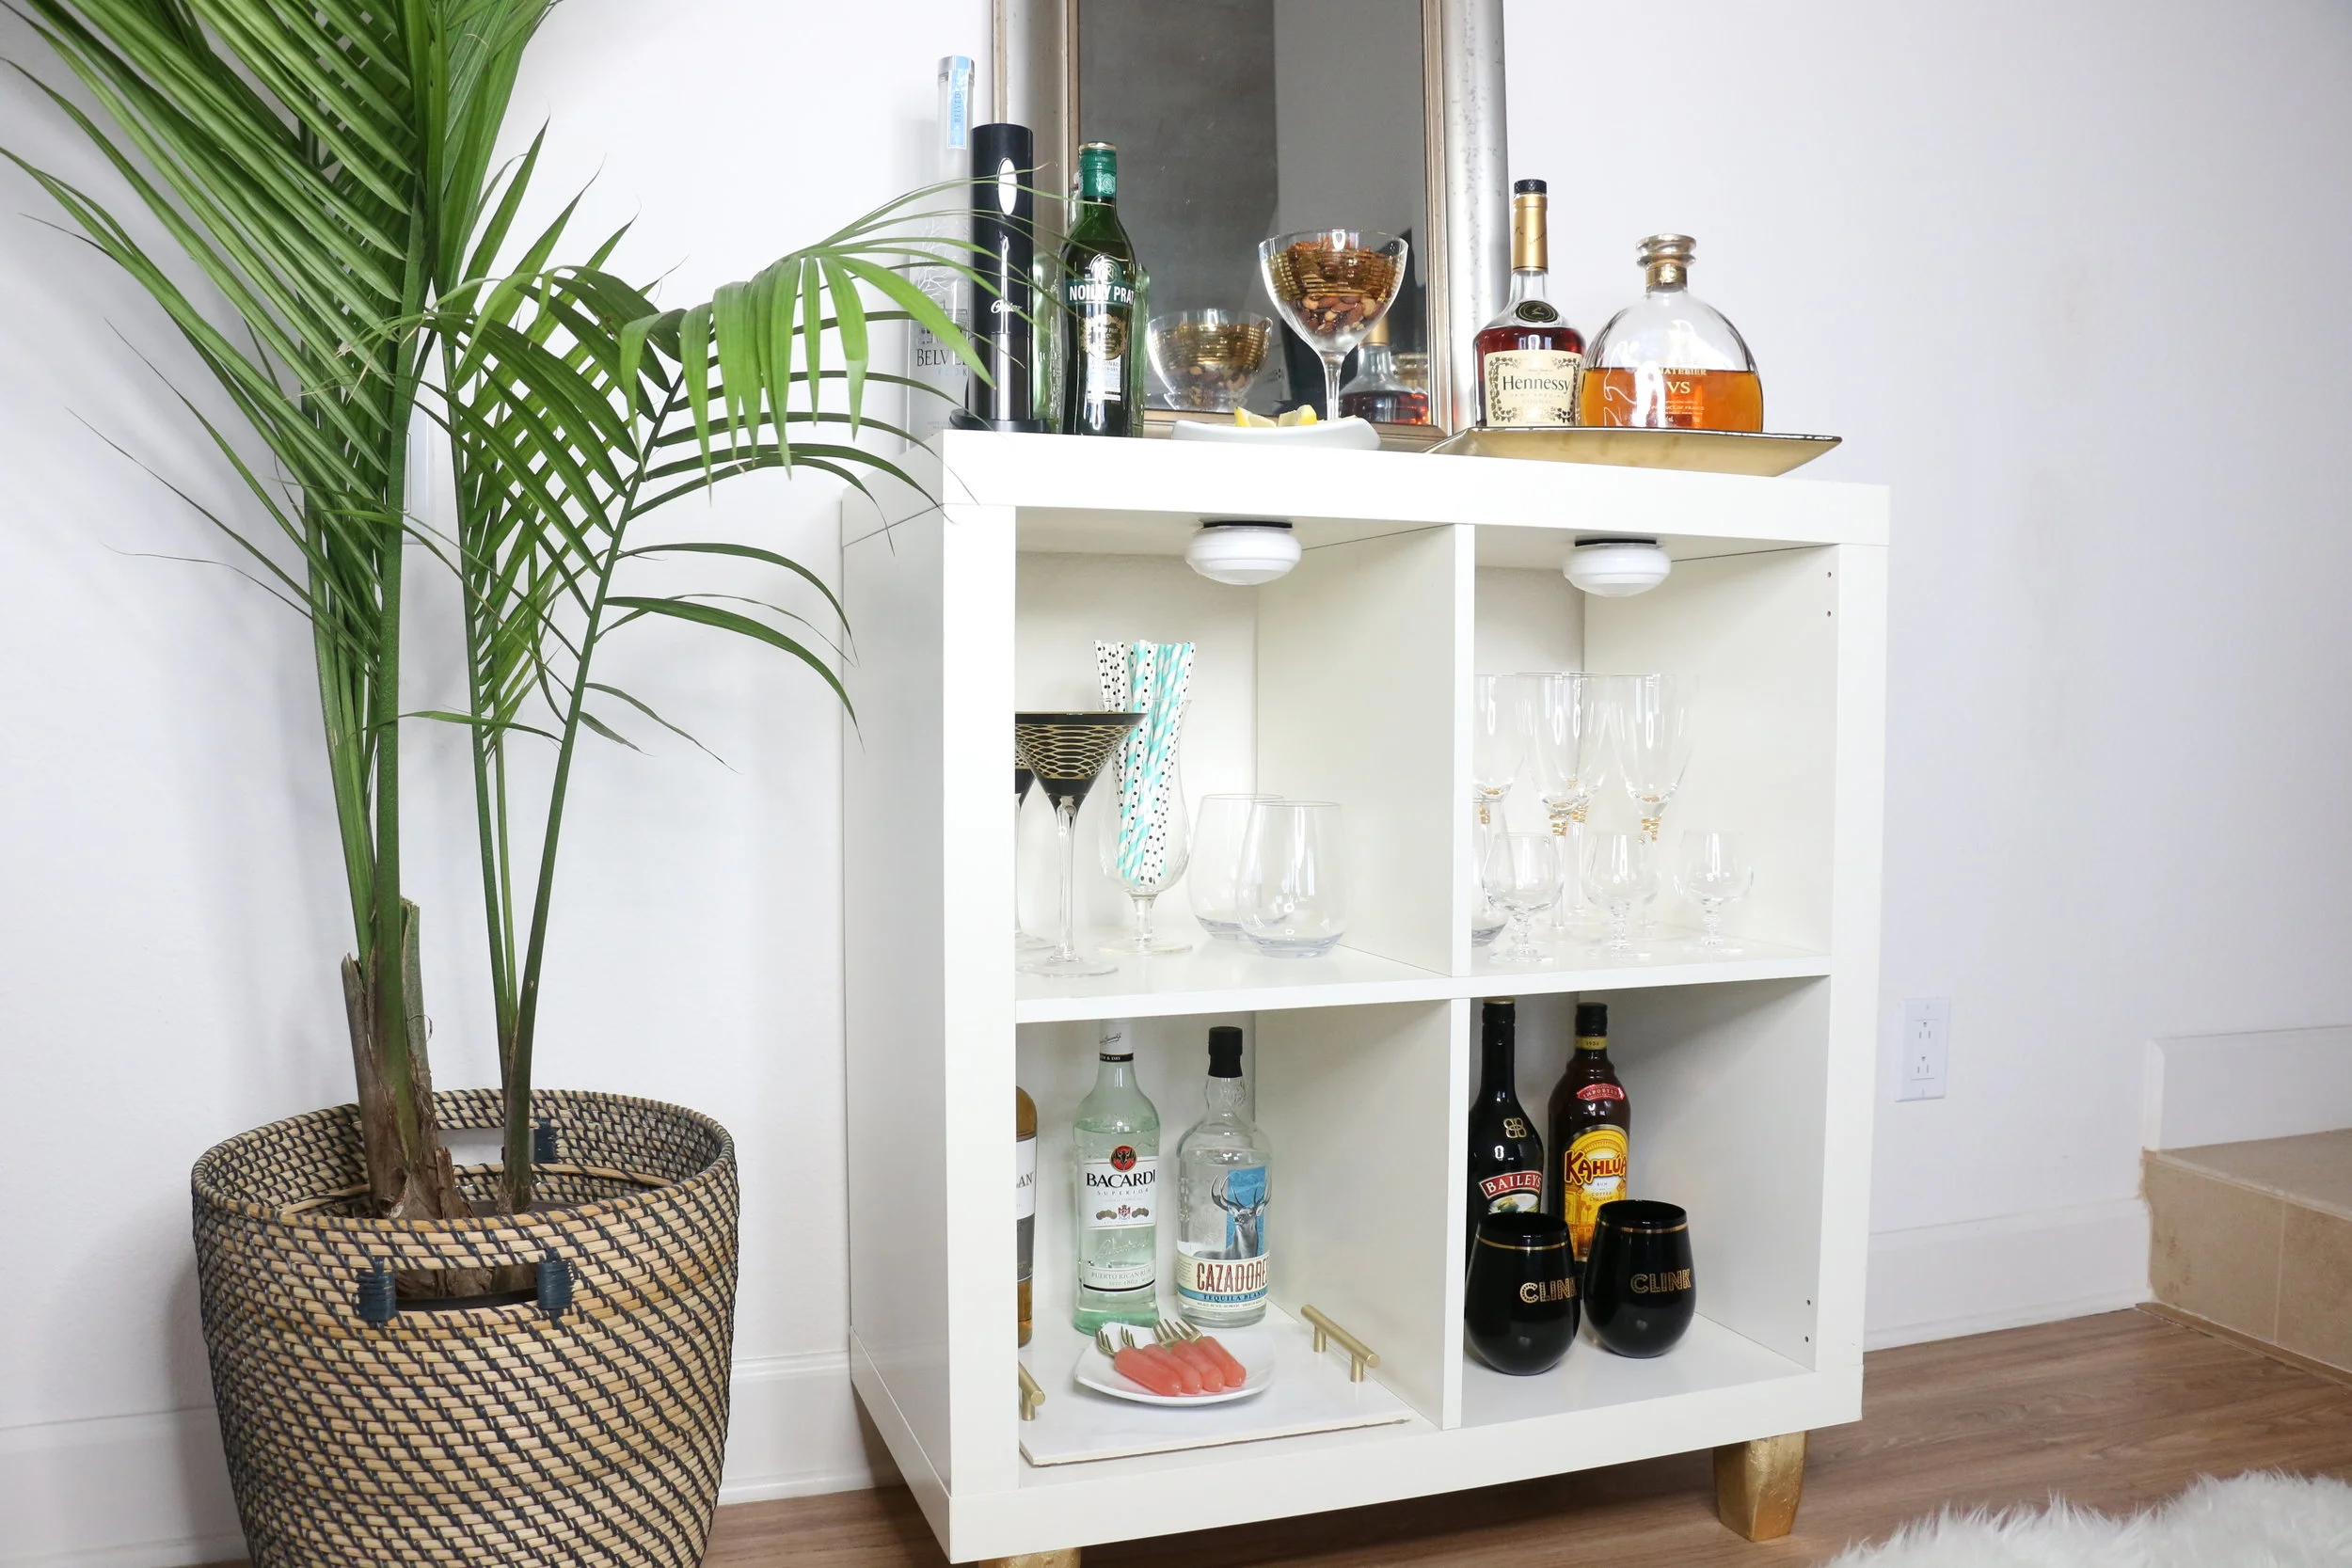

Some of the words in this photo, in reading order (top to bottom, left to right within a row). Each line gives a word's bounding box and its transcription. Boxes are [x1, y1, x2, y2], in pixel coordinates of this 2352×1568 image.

[1502, 375, 1570, 395] Hennessy
[1666, 381, 1691, 394] VS
[1565, 1150, 1627, 1185] KAHLÚA
[1086, 1169, 1156, 1188] BACARDI
[1486, 1174, 1542, 1194] BAILEYS
[1097, 1187, 1149, 1196] SUPERIOR
[1197, 1256, 1269, 1292] CAZADORE
[1630, 1268, 1692, 1293] CLINK
[1204, 1293, 1241, 1303] TEQUILA
[1519, 1276, 1577, 1303] CLINK
